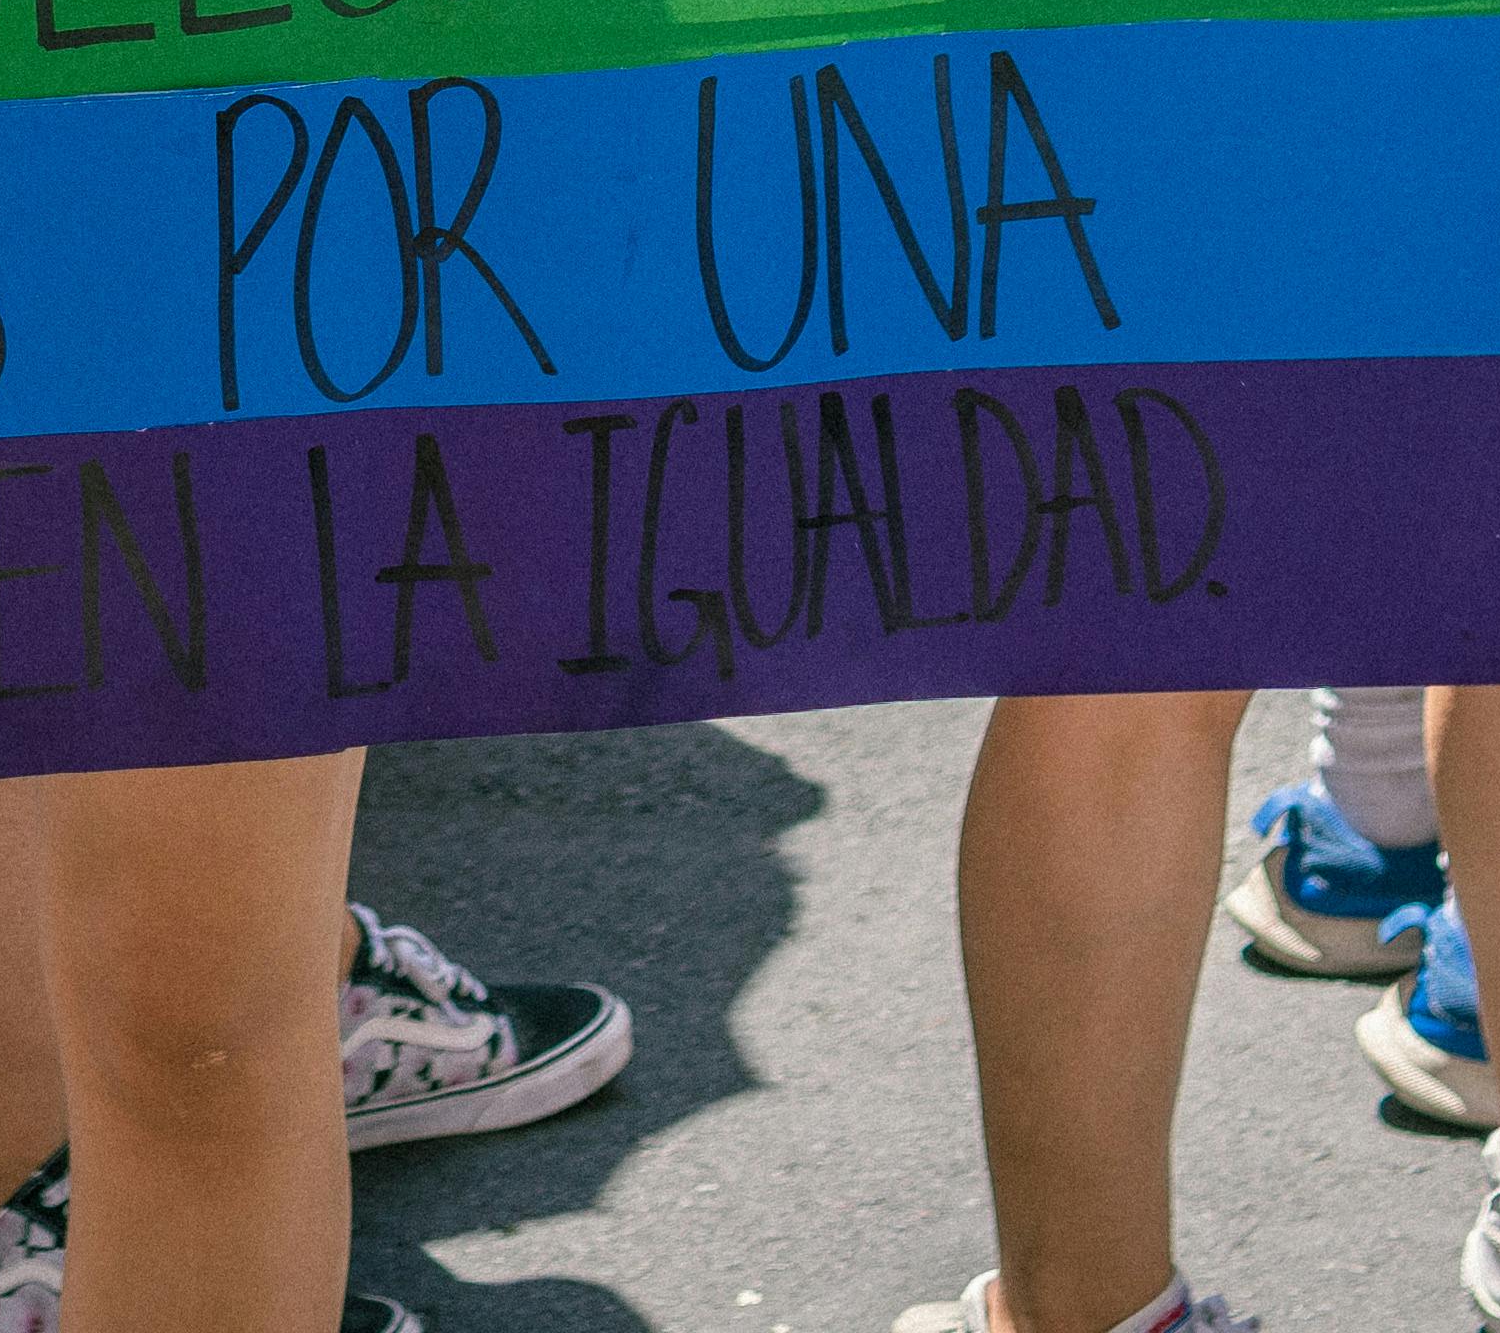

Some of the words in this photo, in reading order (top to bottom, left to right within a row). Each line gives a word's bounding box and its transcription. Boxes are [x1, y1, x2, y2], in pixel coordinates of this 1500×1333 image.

[214, 74, 558, 411] POR
[694, 50, 1122, 372] UNA
[305, 433, 499, 701] LA
[558, 384, 1229, 683] IGUALDAD.
